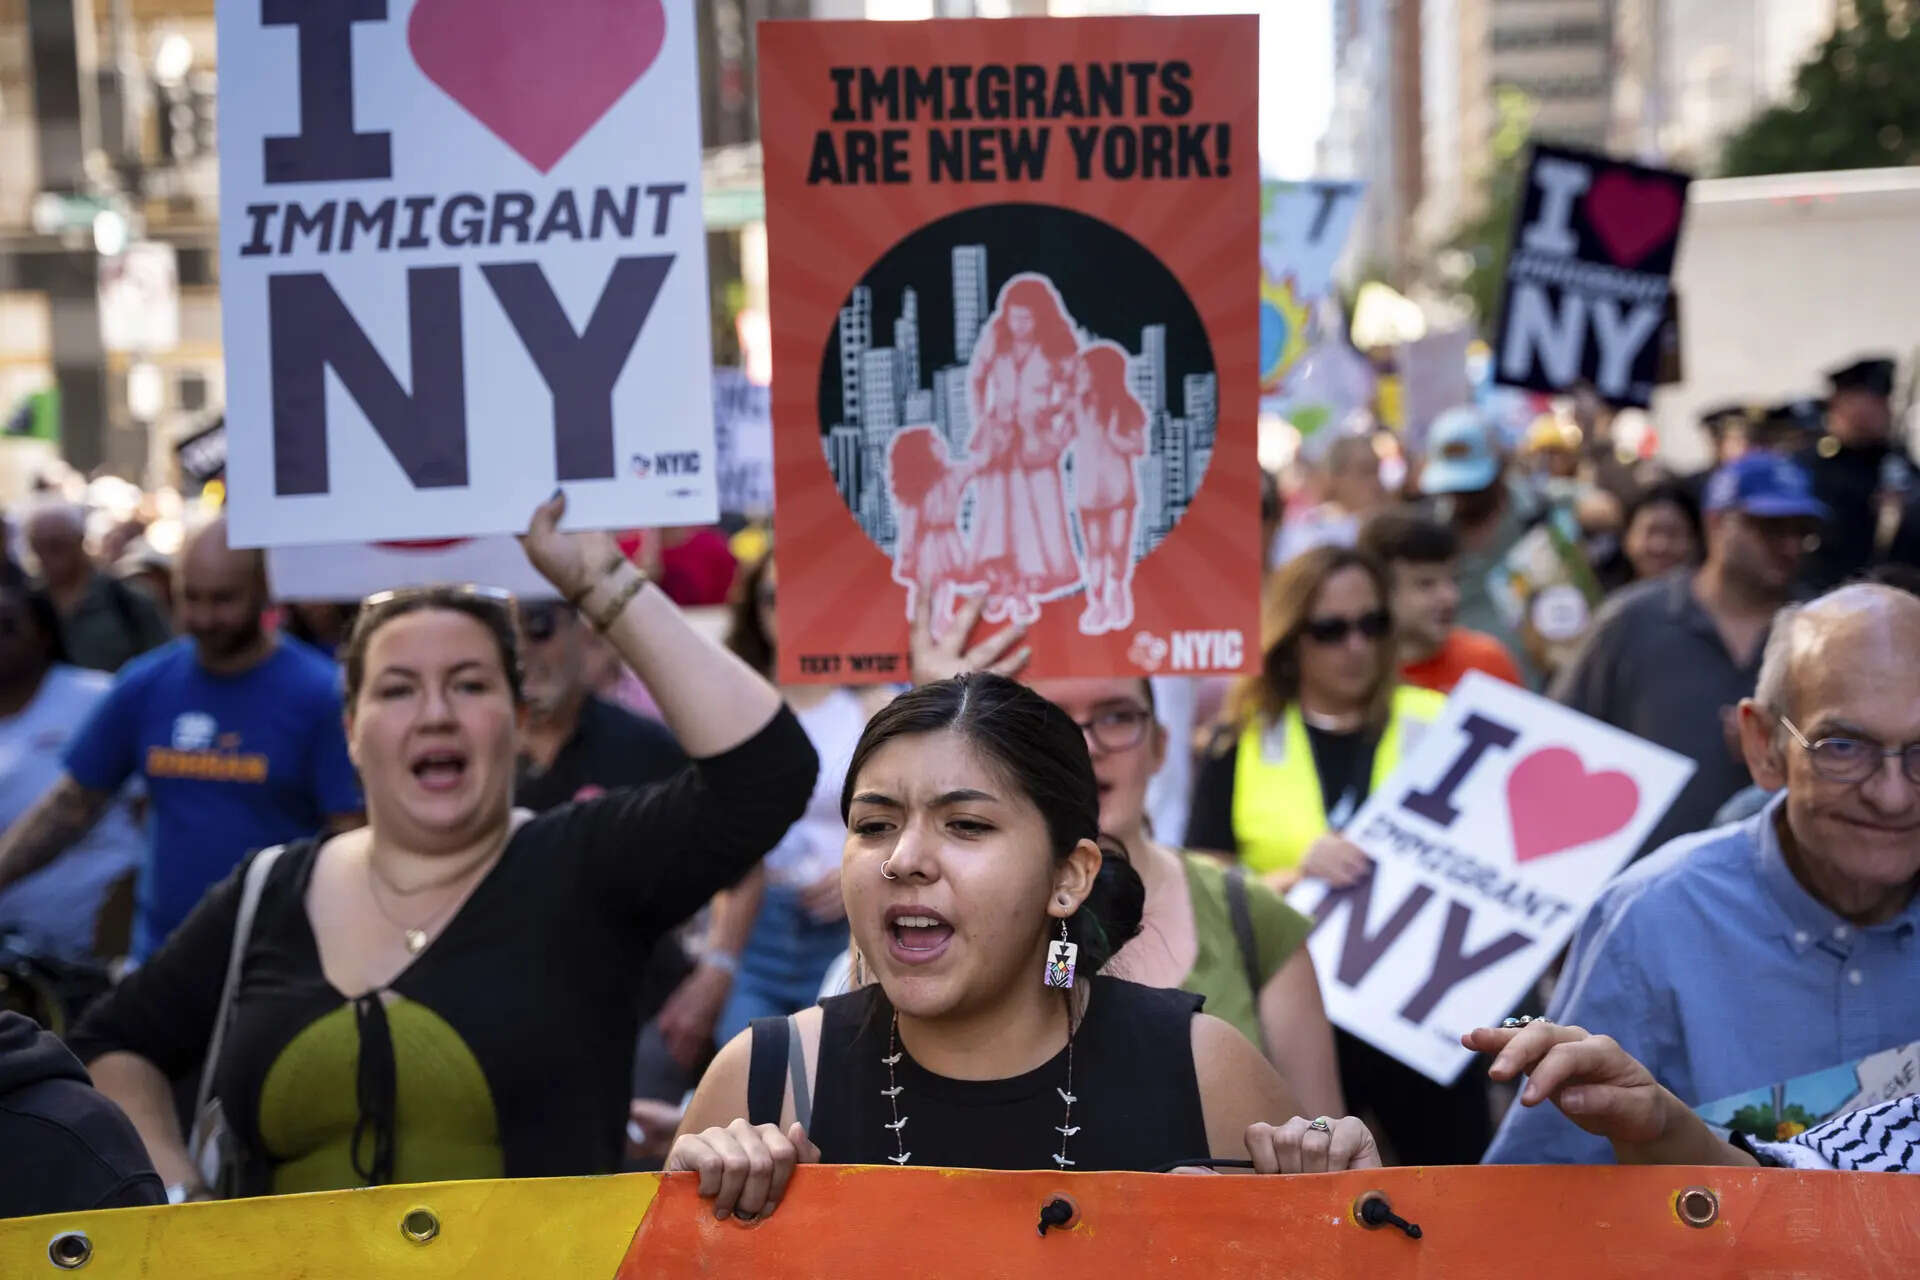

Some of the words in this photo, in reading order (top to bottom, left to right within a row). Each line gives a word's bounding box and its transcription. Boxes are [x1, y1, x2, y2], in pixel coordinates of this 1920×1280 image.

[260, 0, 392, 184] I
[829, 60, 1193, 123] IMMIGRANTS
[806, 129, 910, 186] ARE
[929, 126, 1049, 183] NEW
[1070, 123, 1231, 181] YORK!
[239, 183, 686, 257] IMMIGRANT
[1522, 157, 1593, 252] I
[268, 254, 678, 498] NY
[1500, 283, 1664, 398] NY
[654, 452, 700, 477] NYIC
[1171, 628, 1244, 670] NYIC
[1401, 712, 1520, 828] I
[1306, 858, 1534, 1026] NY
